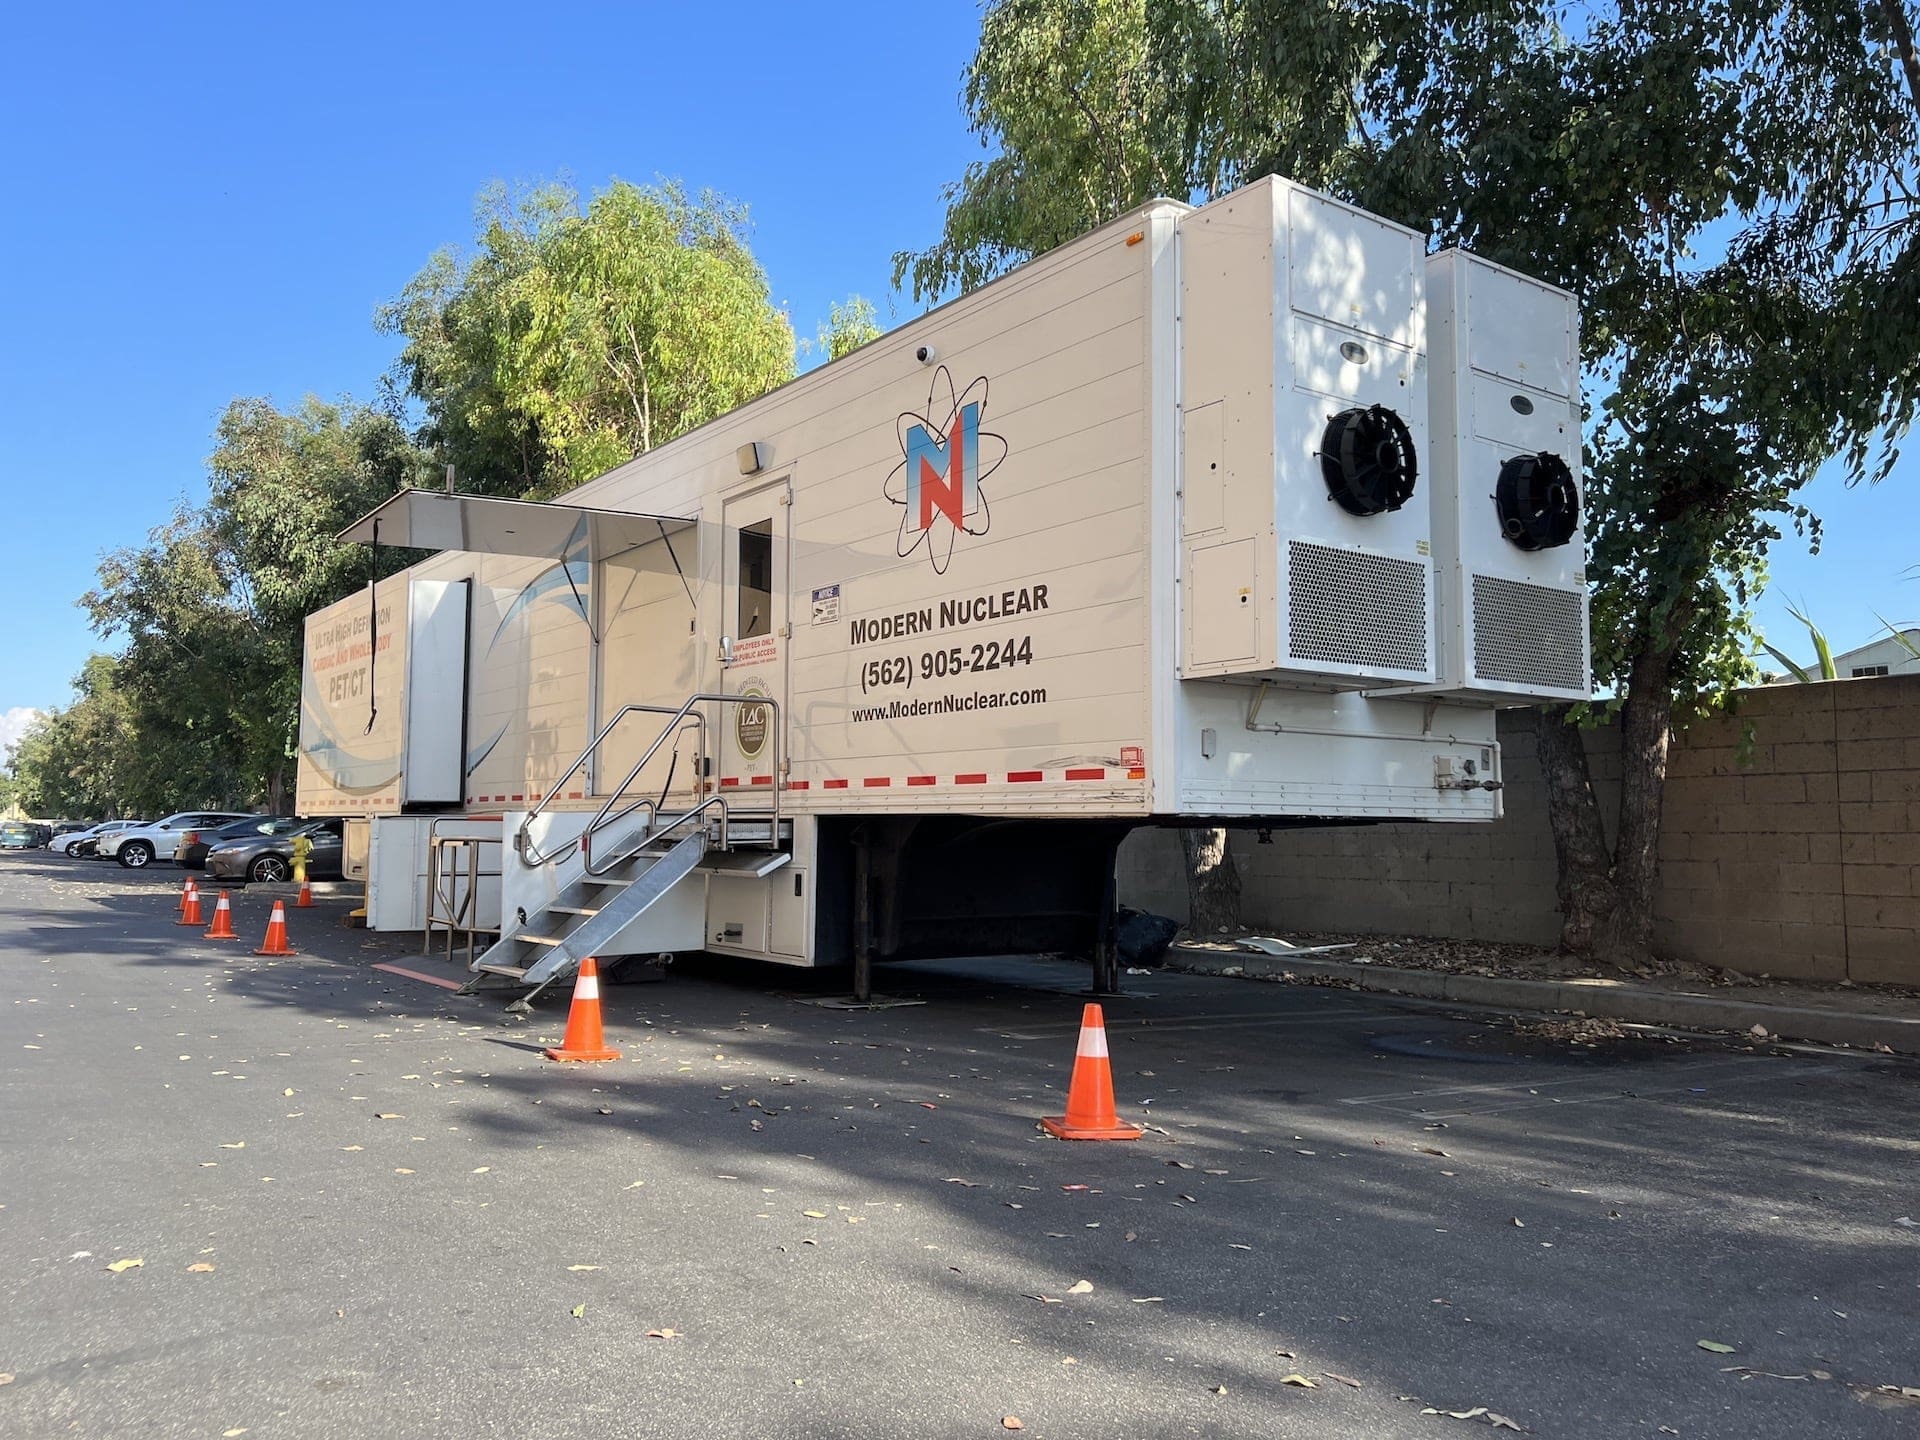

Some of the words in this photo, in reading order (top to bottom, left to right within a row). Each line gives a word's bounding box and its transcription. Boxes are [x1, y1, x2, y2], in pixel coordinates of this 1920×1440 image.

[850, 608, 932, 645] MODERN
[940, 584, 1049, 628] NUCLEAR
[733, 640, 761, 652] EMPLOYEES
[761, 638, 774, 647] ONLY
[739, 651, 756, 661] PUBLIC
[757, 647, 776, 657] ACCESS
[861, 655, 913, 694] (562)
[921, 635, 1032, 680] 905-2244
[329, 667, 366, 703] PET/CT
[741, 706, 765, 726] IAC
[852, 687, 1047, 723] www.ModernNuclear.com
